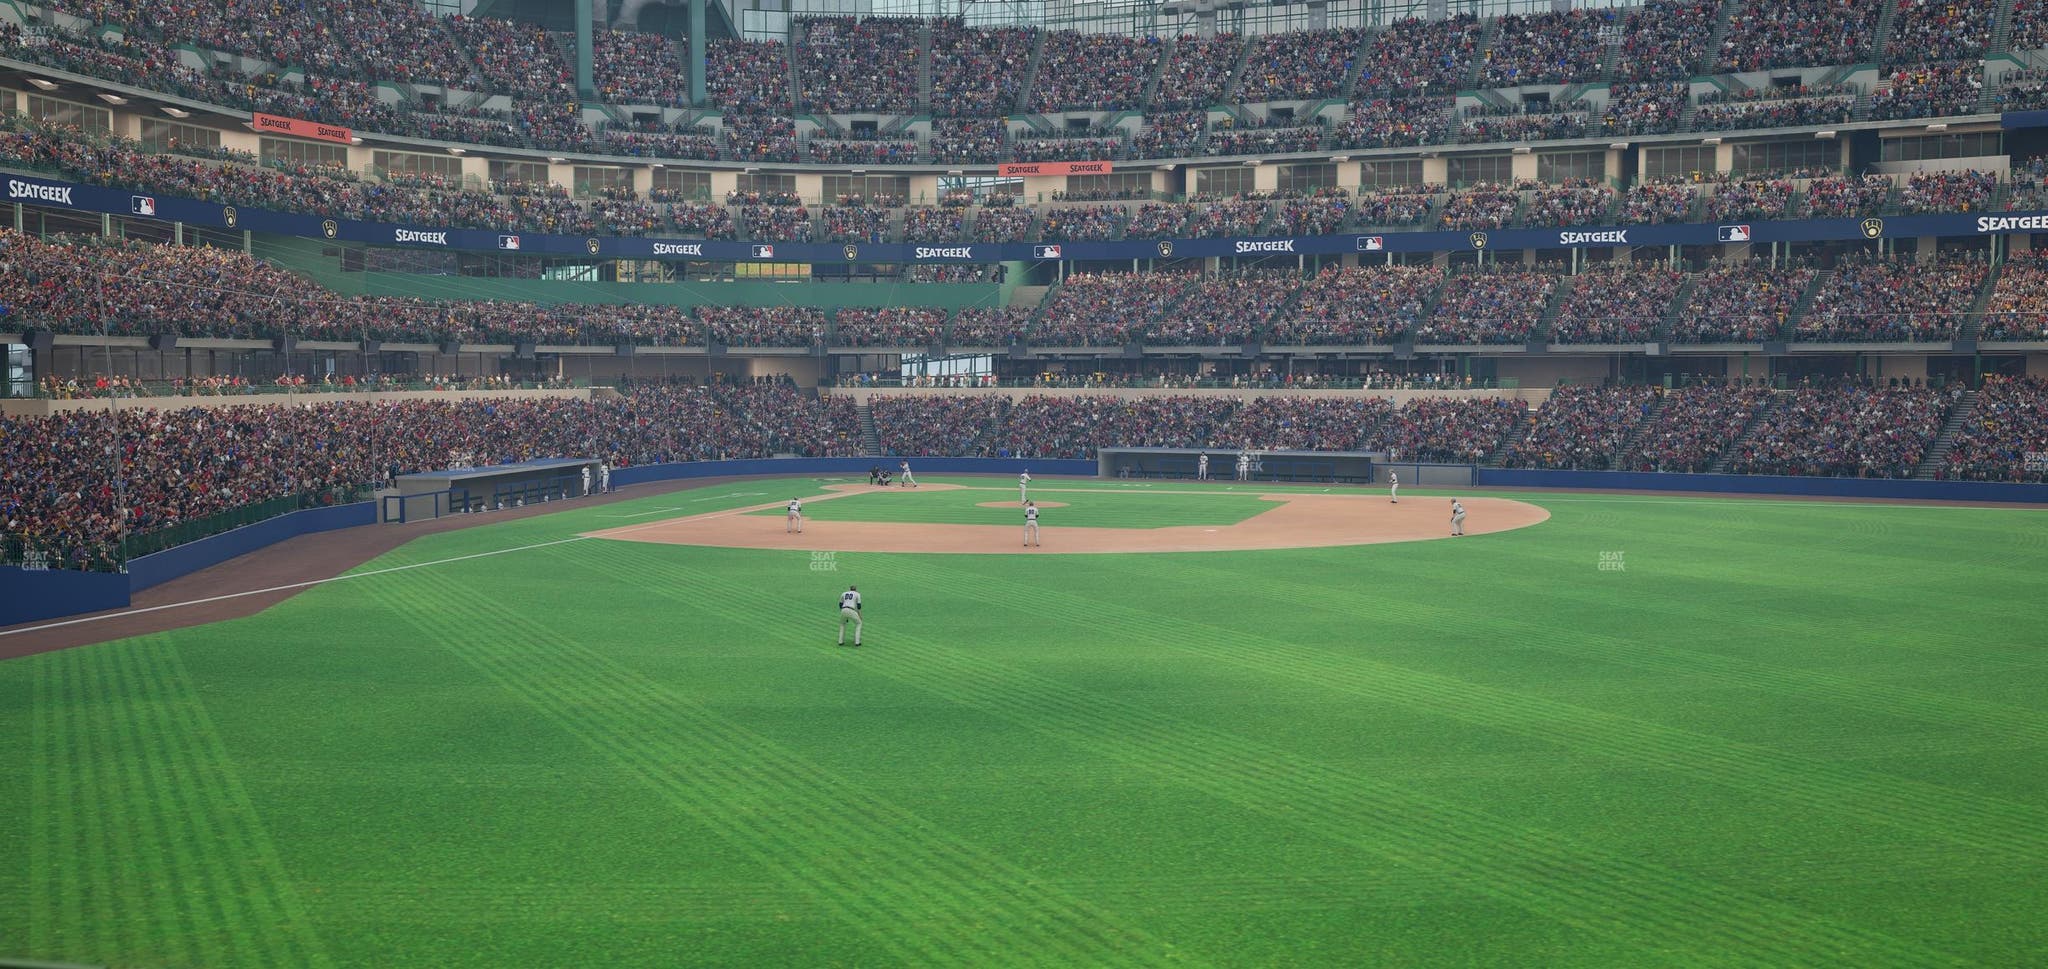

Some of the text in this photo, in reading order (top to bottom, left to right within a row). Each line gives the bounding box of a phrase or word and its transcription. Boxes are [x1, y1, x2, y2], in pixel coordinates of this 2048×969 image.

[261, 117, 291, 130] SEATGEEK
[318, 127, 346, 140] SEATGEEK
[1007, 166, 1040, 174] SEATGEEK
[1070, 164, 1103, 172] SEATGEEK
[9, 179, 72, 205] SEATGEEK
[395, 229, 447, 245] SEATGEEK
[1560, 230, 1628, 244] SEATGEEK
[653, 243, 702, 256] SEATGEEK
[915, 246, 972, 258] SEATGEEK
[1236, 240, 1294, 253] SEATGEEK
